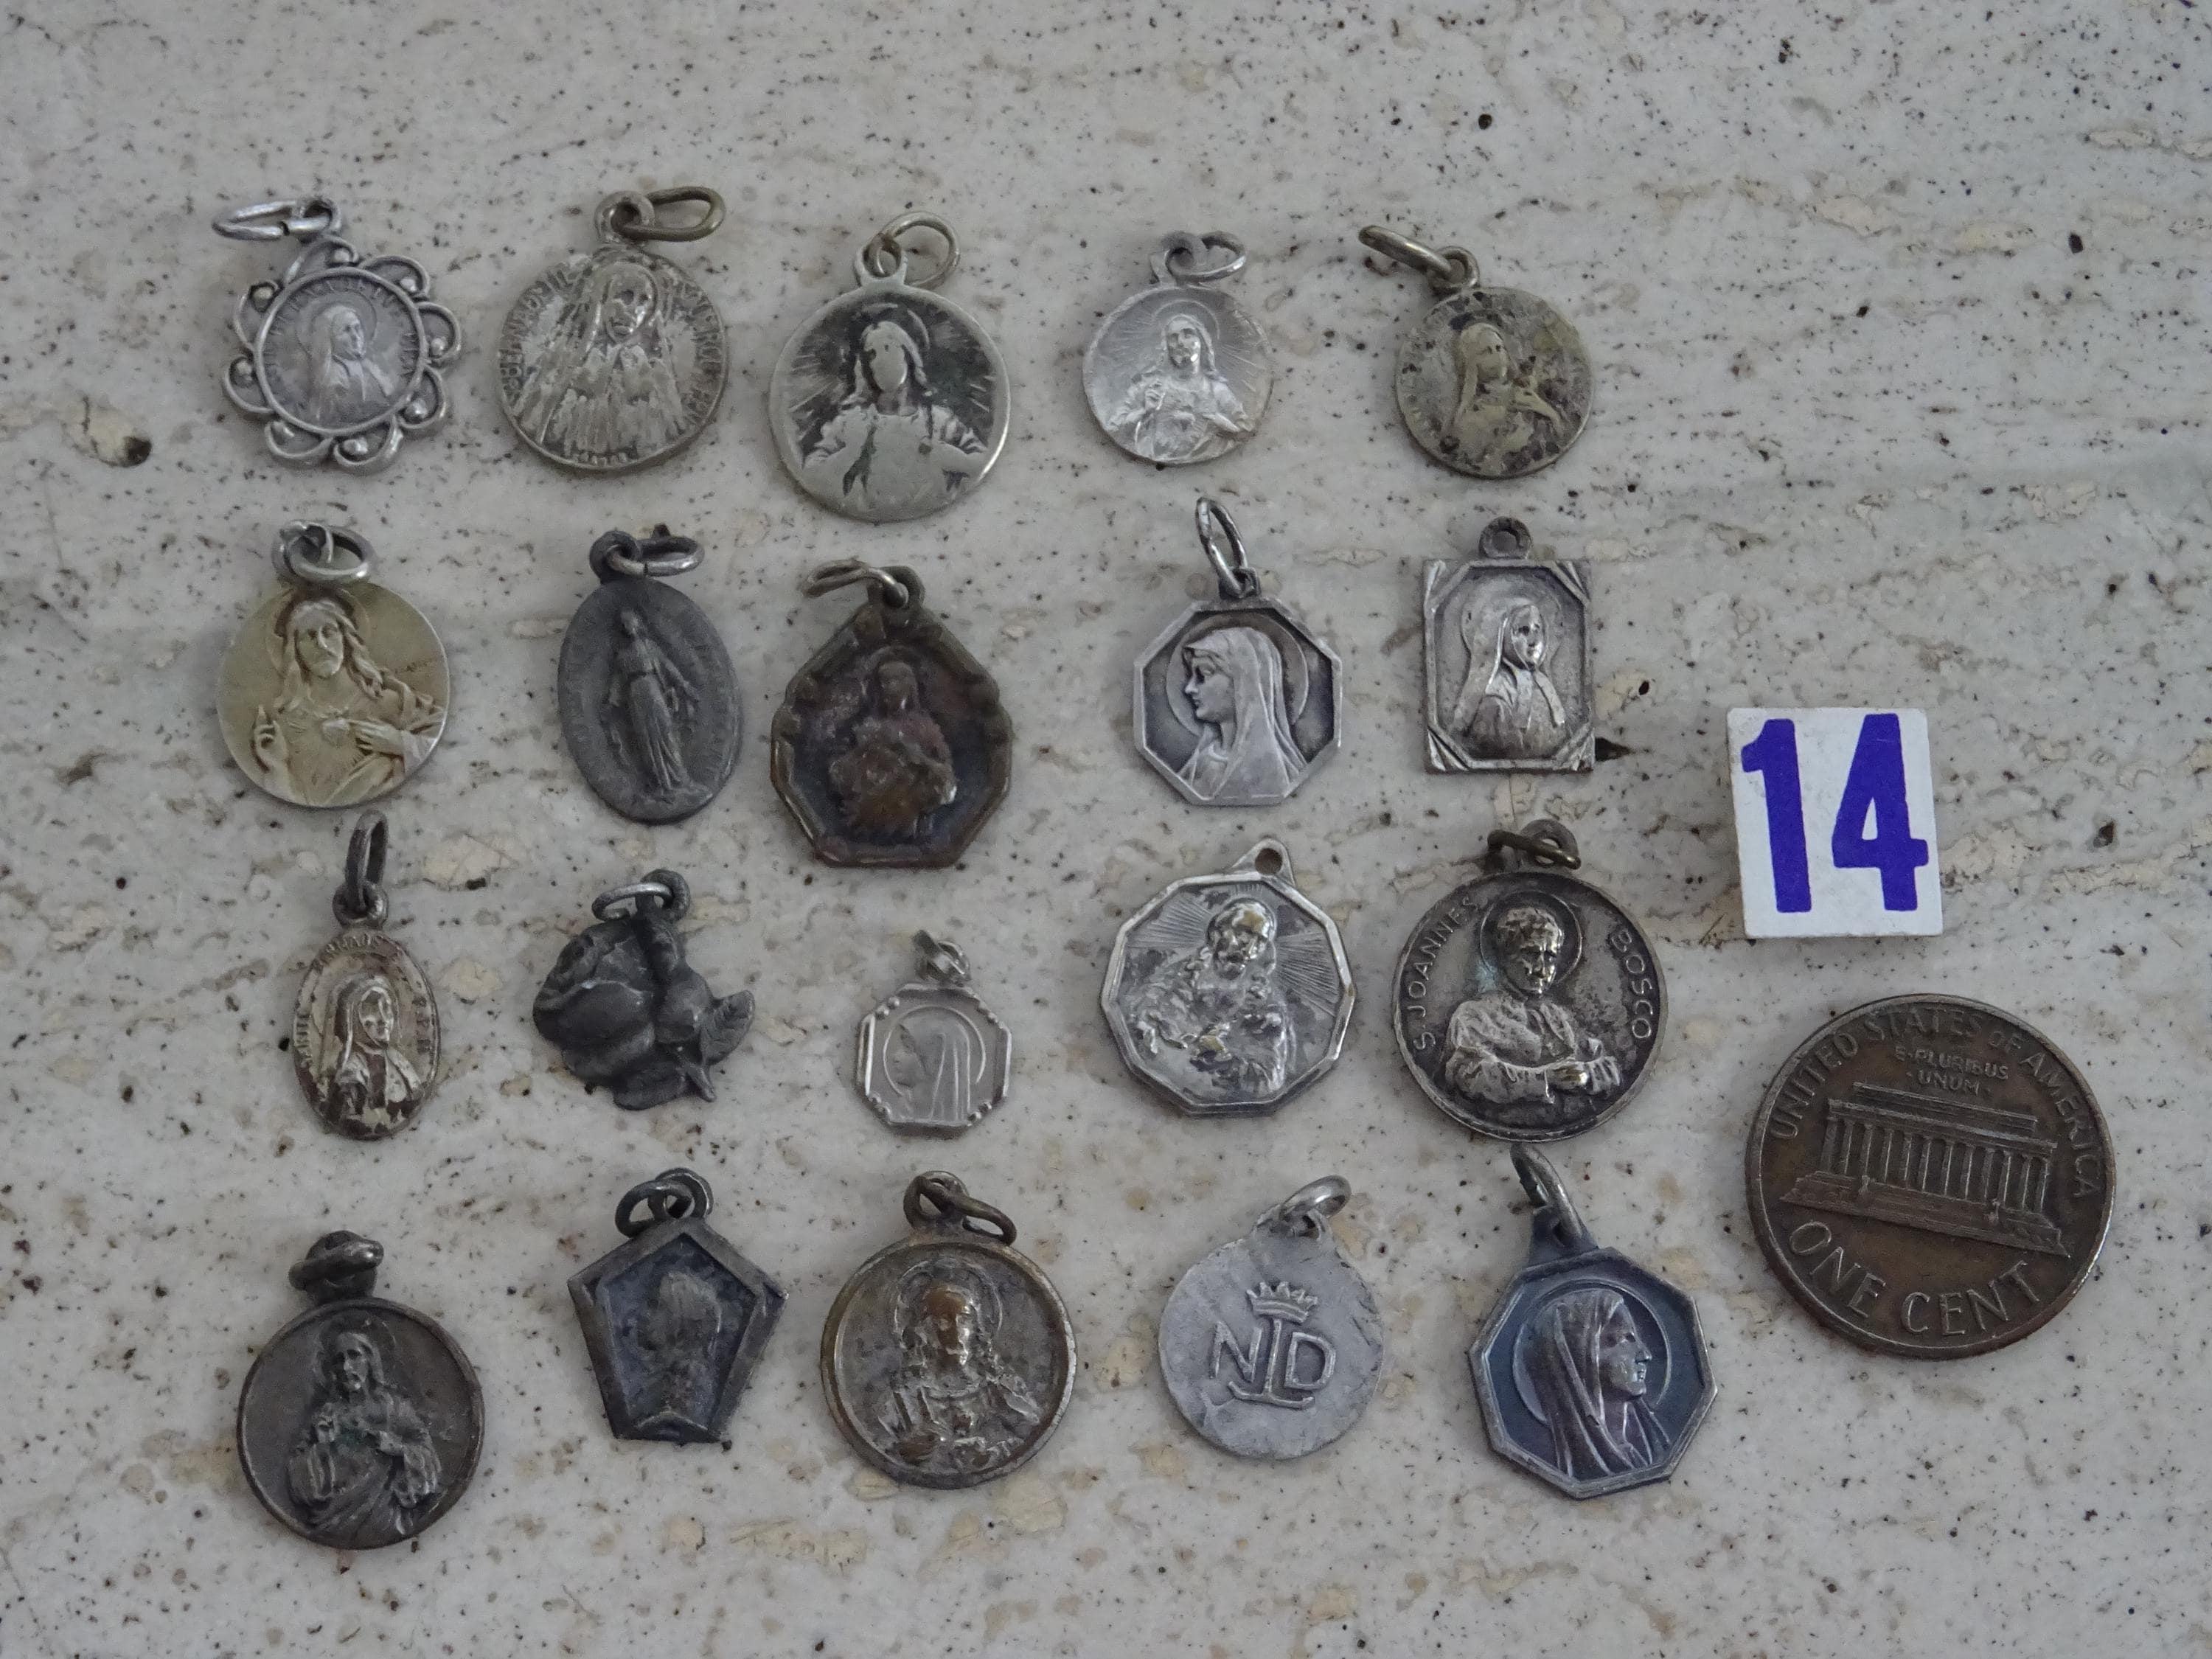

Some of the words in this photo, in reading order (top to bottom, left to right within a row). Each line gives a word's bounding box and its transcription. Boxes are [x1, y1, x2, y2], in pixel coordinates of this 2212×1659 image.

[1741, 713, 1929, 913] 14
[1610, 930, 1653, 1040] BOSCO
[1770, 1031, 1858, 1139] UNITED
[1863, 1007, 1983, 1042] STATES
[1989, 1030, 2023, 1055] OF
[2018, 1051, 2103, 1198] AMERICA
[1790, 1220, 1886, 1318] ONE
[1901, 1259, 2039, 1336] CENT
